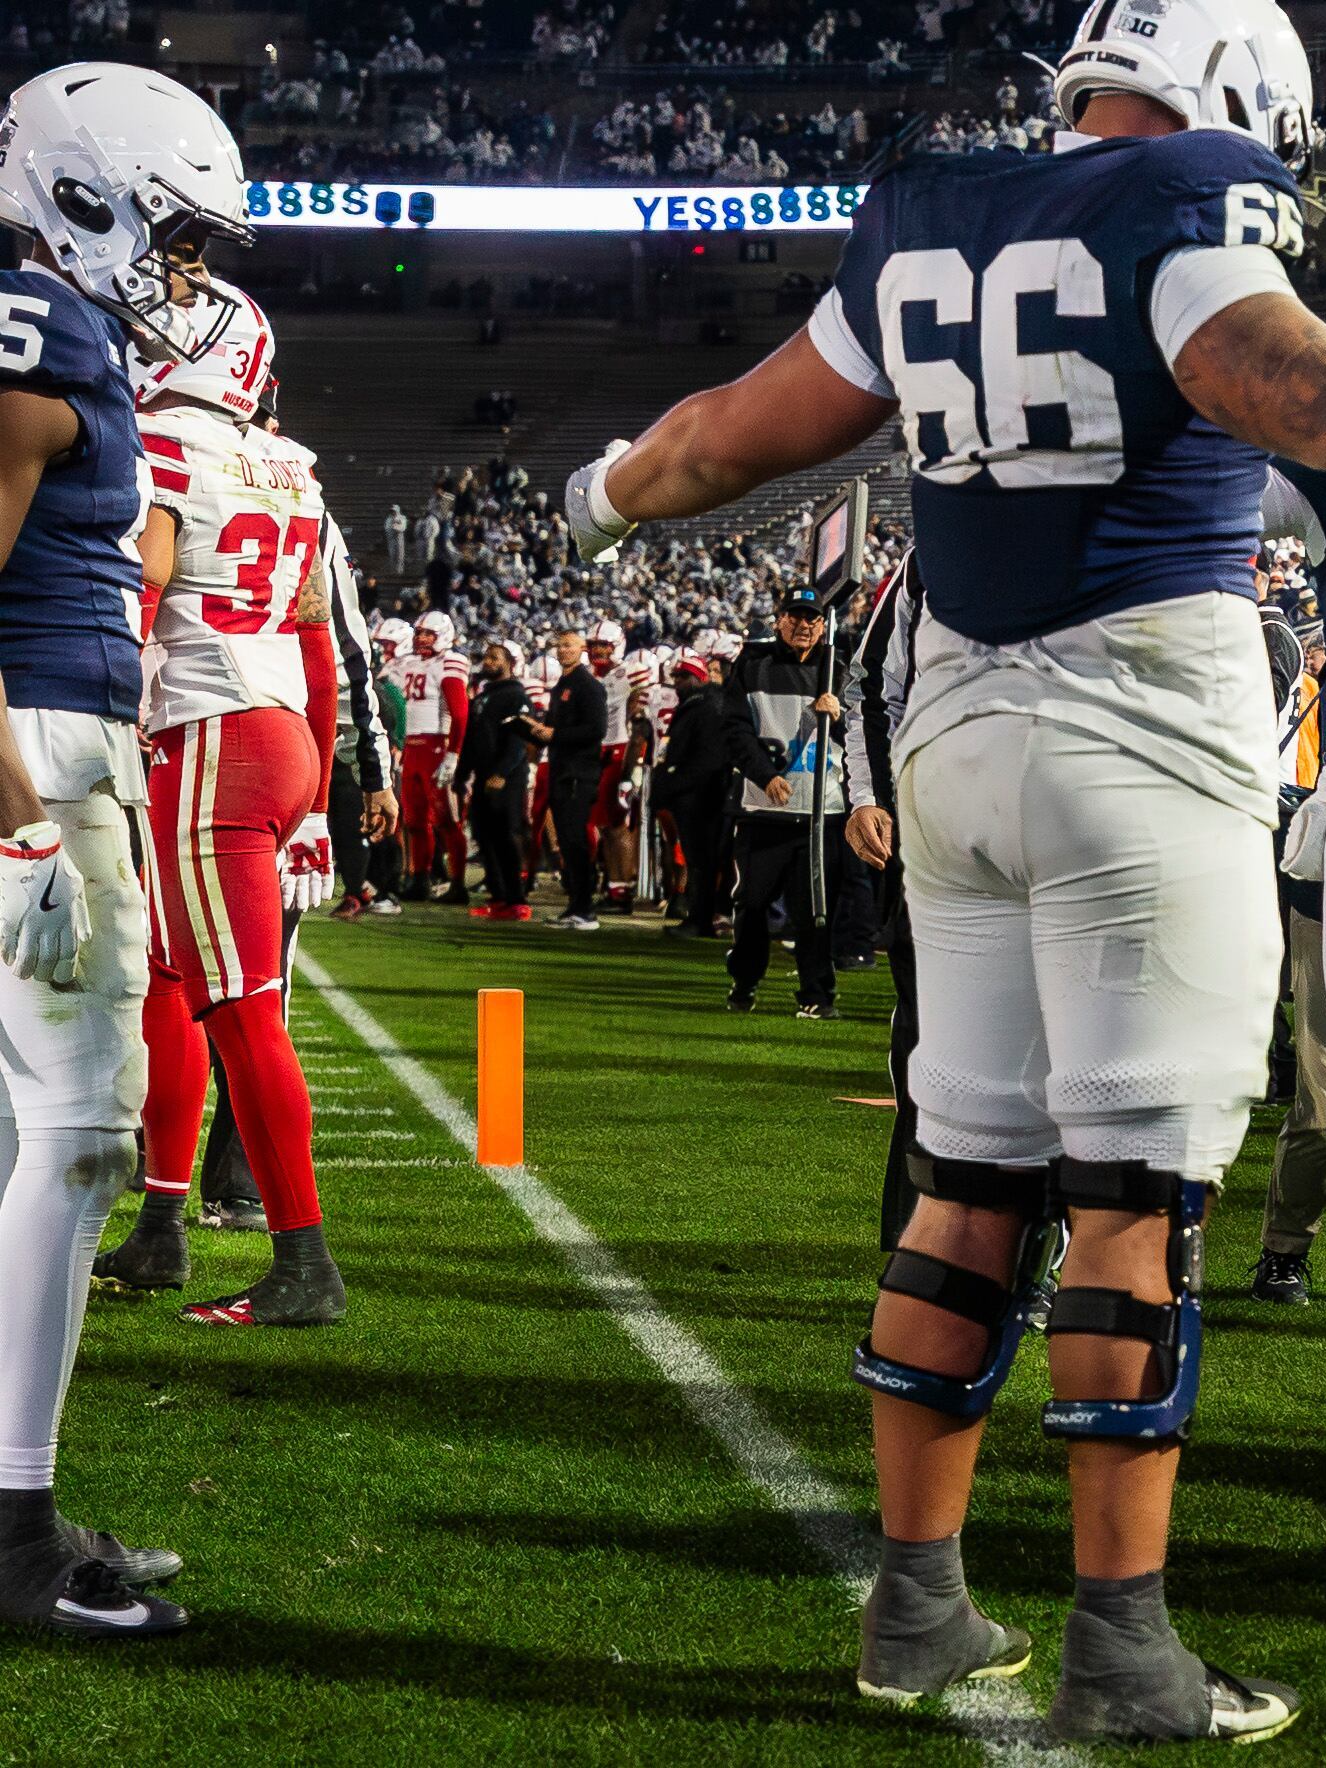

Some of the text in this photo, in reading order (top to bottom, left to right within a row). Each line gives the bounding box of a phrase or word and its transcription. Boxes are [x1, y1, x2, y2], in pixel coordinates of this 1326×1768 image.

[1225, 182, 1304, 258] 66
[876, 237, 1126, 488] 66
[202, 512, 320, 634] 37
[288, 837, 330, 875] N
